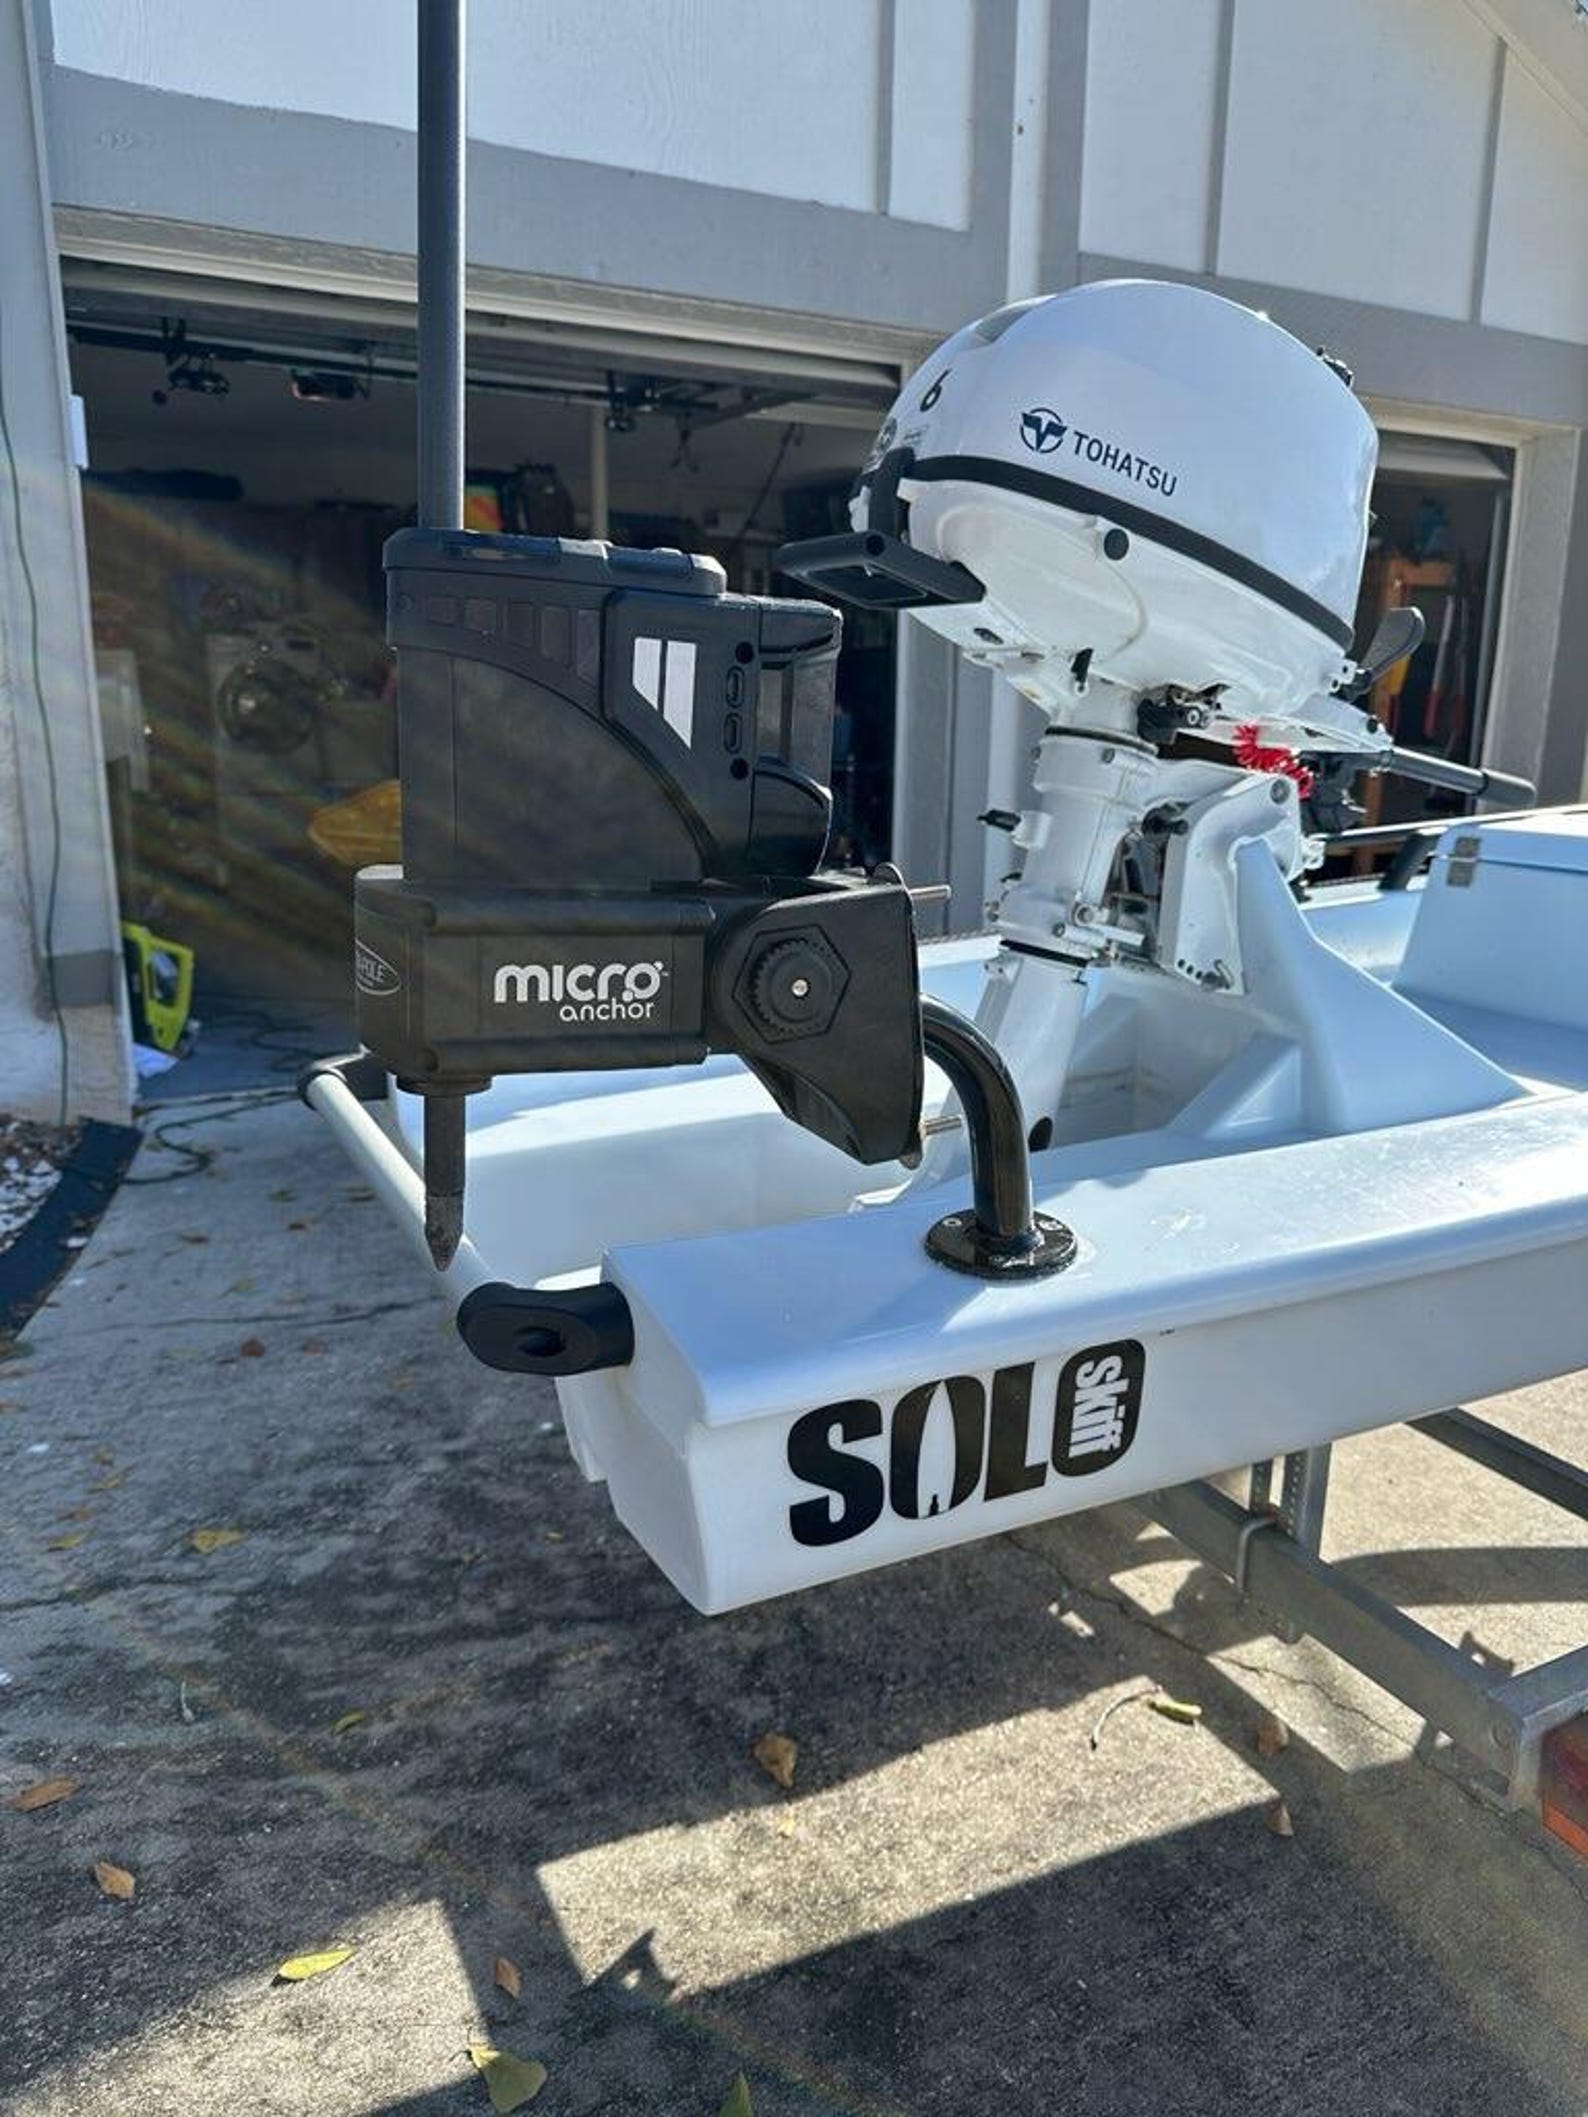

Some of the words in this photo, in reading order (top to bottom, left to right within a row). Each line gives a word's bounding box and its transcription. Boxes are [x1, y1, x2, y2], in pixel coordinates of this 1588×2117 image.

[920, 369, 951, 412] 6
[1073, 430, 1177, 496] TOHATSU
[494, 961, 664, 1003] micro
[559, 997, 654, 1021] anchor
[787, 1339, 1146, 1547] SOLO
